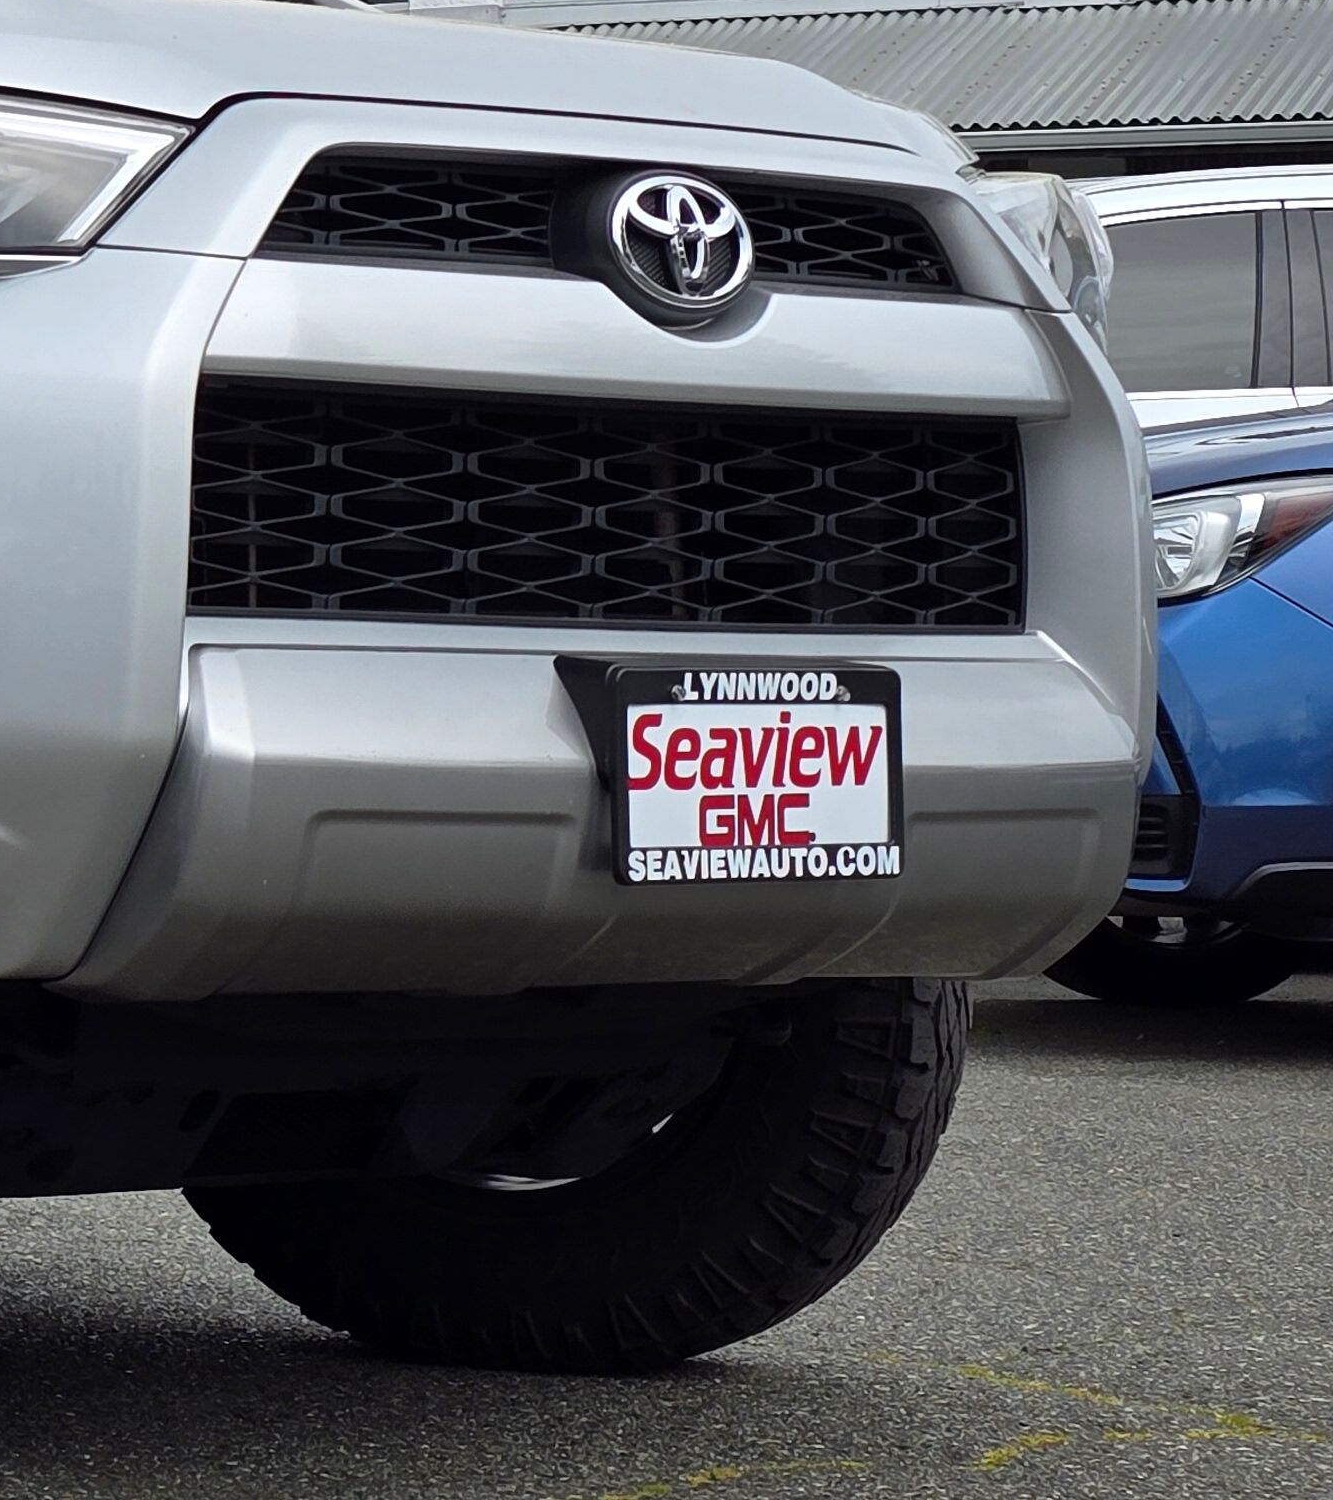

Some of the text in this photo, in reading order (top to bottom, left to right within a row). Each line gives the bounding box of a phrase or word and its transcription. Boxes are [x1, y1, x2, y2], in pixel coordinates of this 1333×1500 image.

[683, 671, 839, 702] LYNNWOOD
[628, 710, 884, 791] Seaview
[698, 792, 812, 848] GMC
[627, 845, 901, 883] SEAVIEWAUTO.COM
